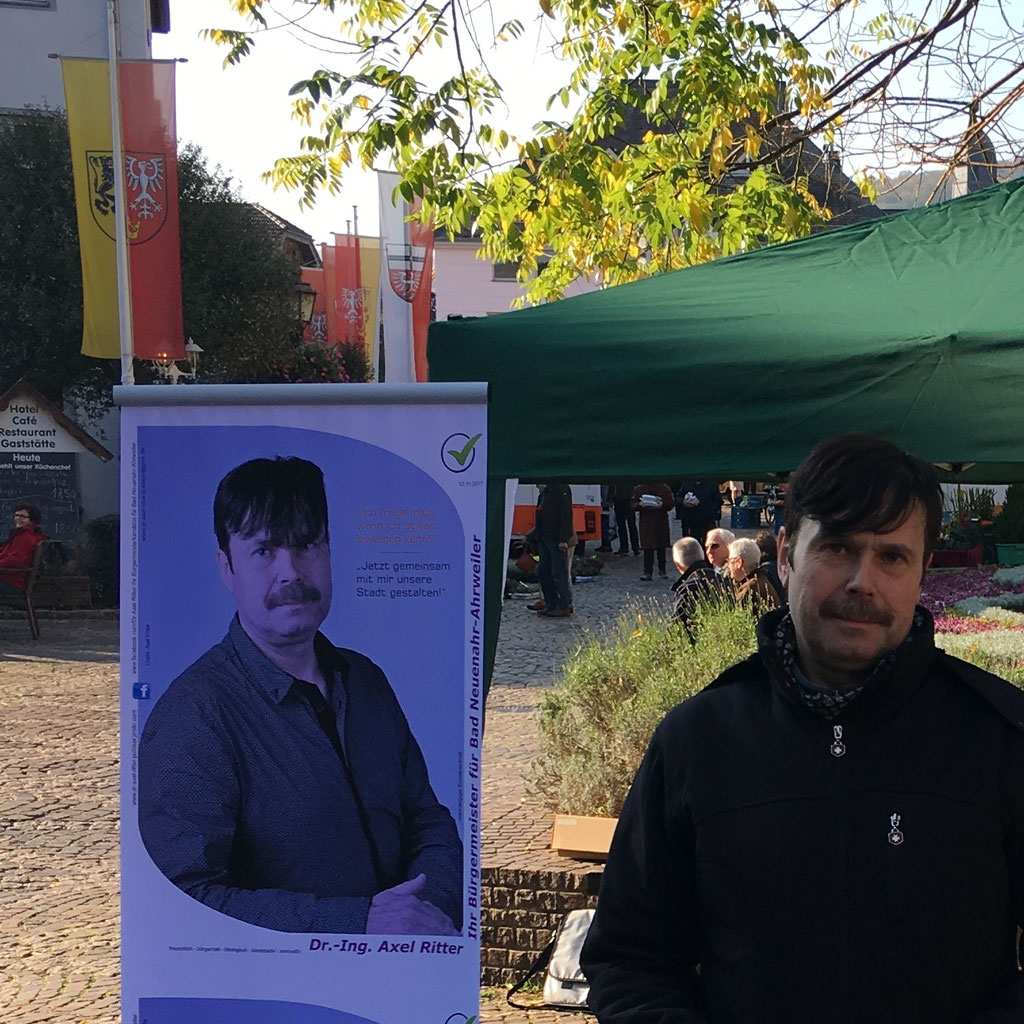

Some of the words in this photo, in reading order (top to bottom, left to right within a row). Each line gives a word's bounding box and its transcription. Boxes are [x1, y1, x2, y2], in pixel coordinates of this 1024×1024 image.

[9, 404, 39, 414] Hotel
[12, 416, 38, 425] Café
[0, 428, 57, 437] Restaurant
[1, 439, 56, 448] Gaststätte
[12, 453, 41, 462] Heute
[393, 562, 451, 573] gemeinsam
[356, 576, 374, 584] mit
[376, 576, 394, 584] mir
[356, 587, 387, 598] Stadt
[469, 534, 482, 711] Neuenahr-Ahrweiler
[469, 716, 480, 749] Bad
[468, 754, 479, 779] für
[468, 784, 480, 908] Bürgermeister
[468, 912, 479, 941] Ihr
[309, 938, 372, 955] Dr.-Ing.
[377, 940, 416, 954] Axel
[420, 941, 464, 955] Ritter
